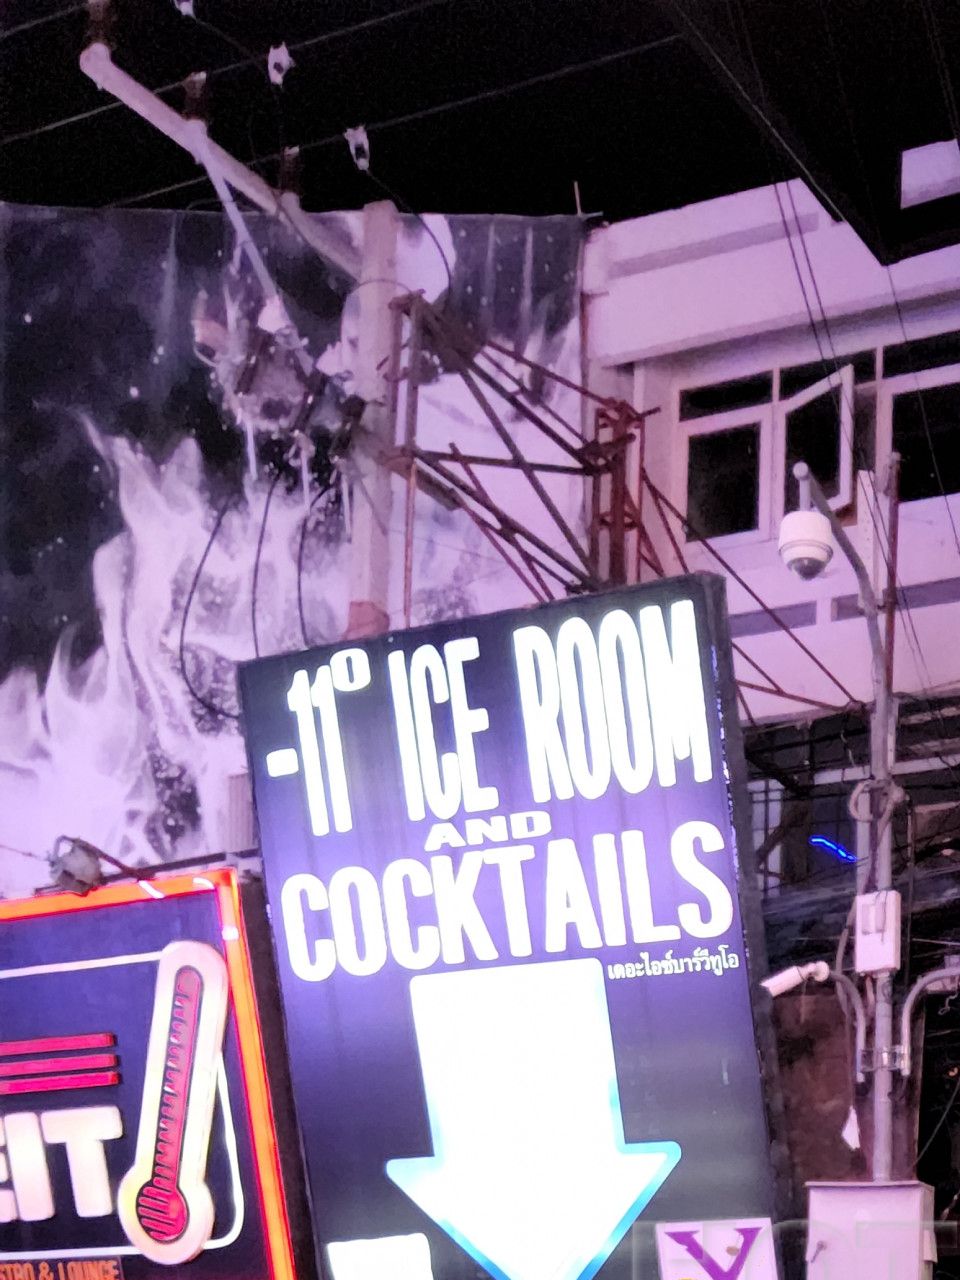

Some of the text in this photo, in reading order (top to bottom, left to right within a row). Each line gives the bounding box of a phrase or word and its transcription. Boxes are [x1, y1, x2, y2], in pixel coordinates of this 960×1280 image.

[388, 636, 499, 820] ICE
[513, 599, 713, 803] ROOM
[280, 820, 733, 982] COCKTAILS
[423, 810, 552, 852] AND
